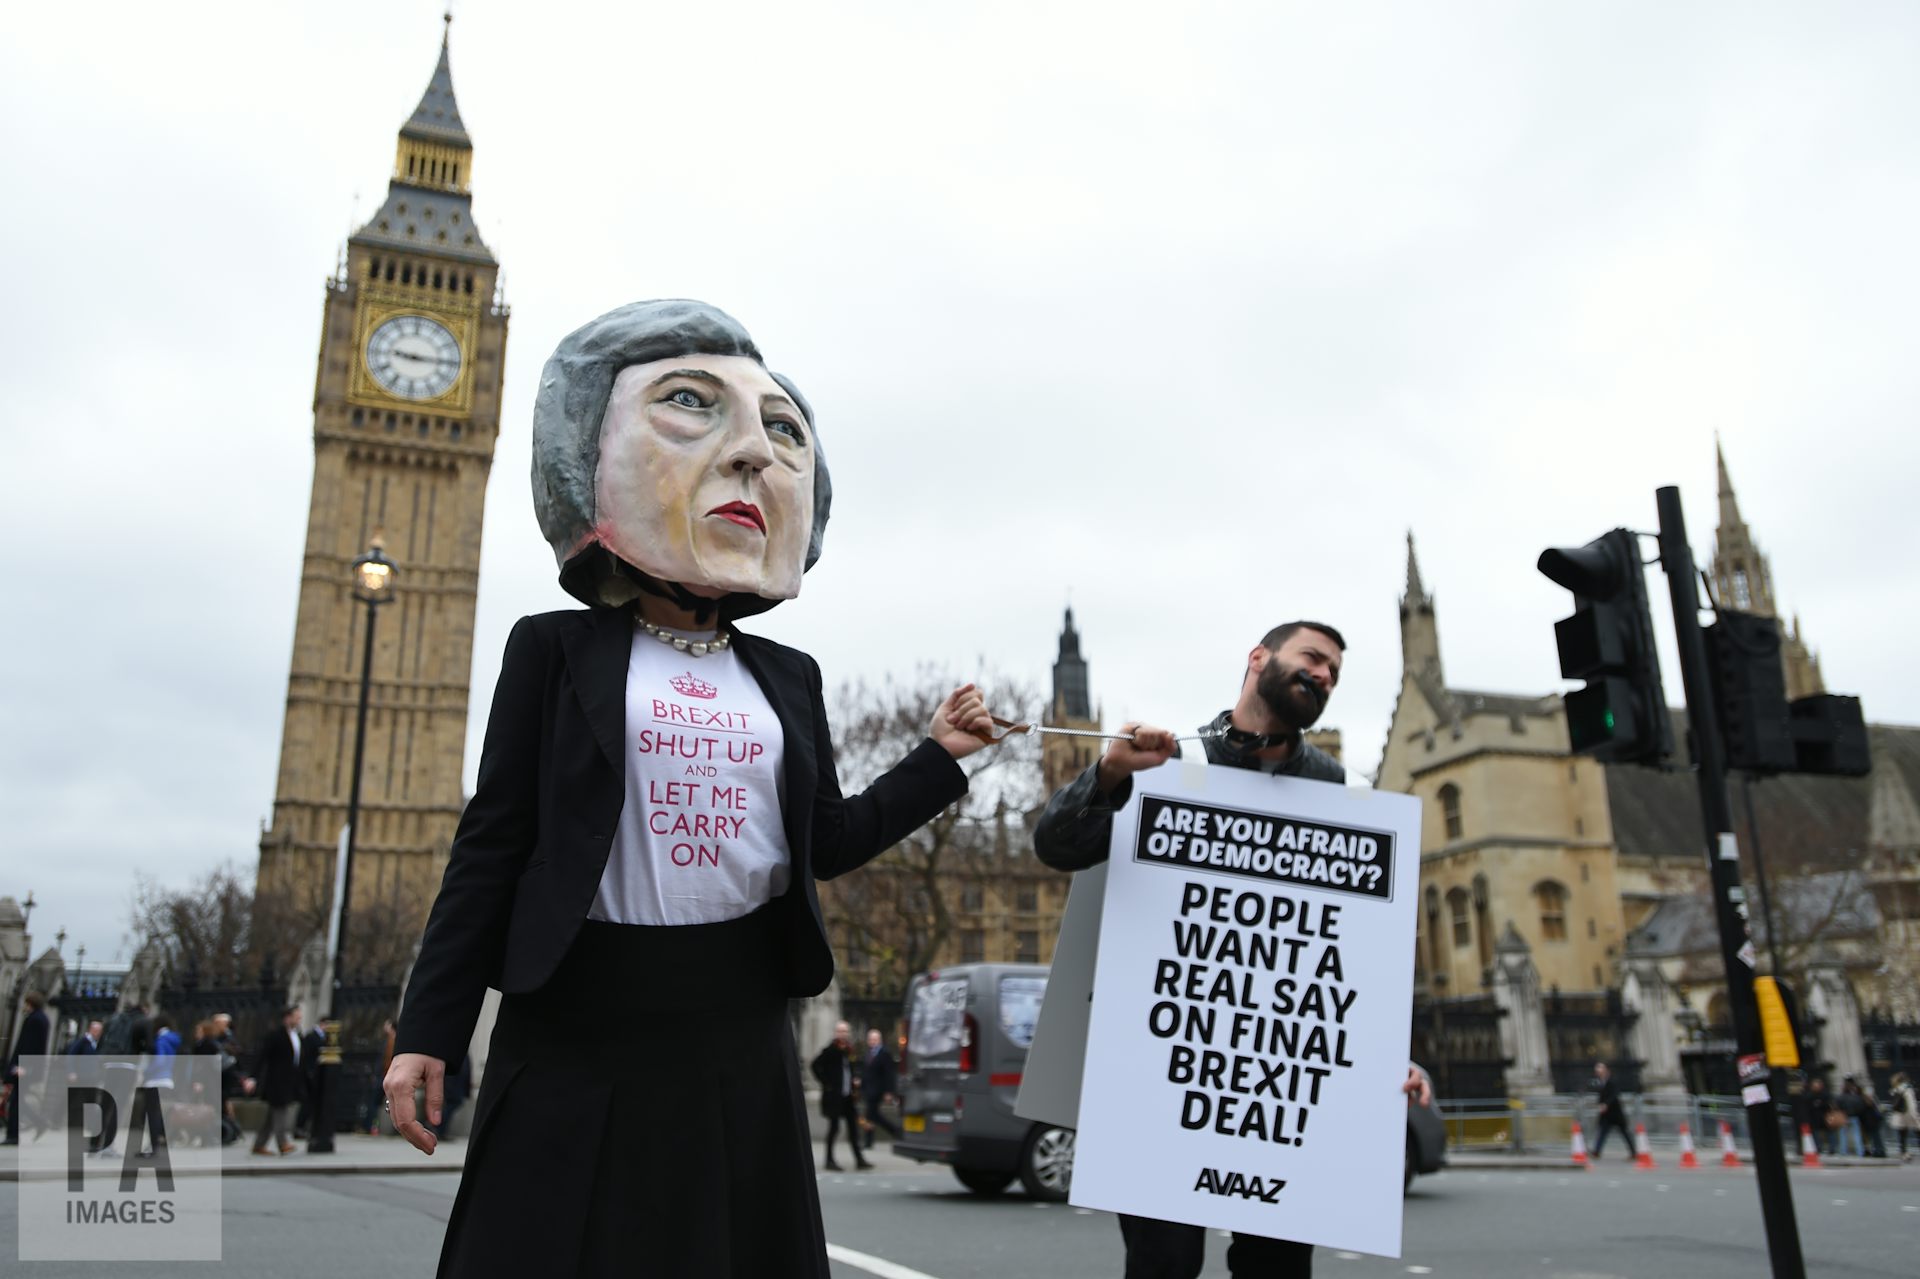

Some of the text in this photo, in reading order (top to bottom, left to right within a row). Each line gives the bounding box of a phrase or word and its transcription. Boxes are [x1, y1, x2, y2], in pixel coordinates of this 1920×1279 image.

[652, 699, 750, 729] BREXIT
[638, 730, 763, 764] SHUT UP
[685, 765, 717, 778] AND
[650, 780, 747, 810] LET ME
[650, 811, 746, 839] CARRY
[1154, 805, 1377, 862] ARE YOU AFRAID
[671, 843, 720, 867] ON
[1147, 832, 1382, 890] OF DEMOCRACY?
[1180, 882, 1341, 940] PEOPLE
[1173, 920, 1343, 981] WANT A
[1154, 959, 1358, 1024] REAL SAY
[1149, 1001, 1353, 1068] ON FINAL
[1168, 1046, 1330, 1105] BREXIT
[1180, 1091, 1308, 1147] DEAL!
[1194, 1168, 1287, 1204] AVAAZ
